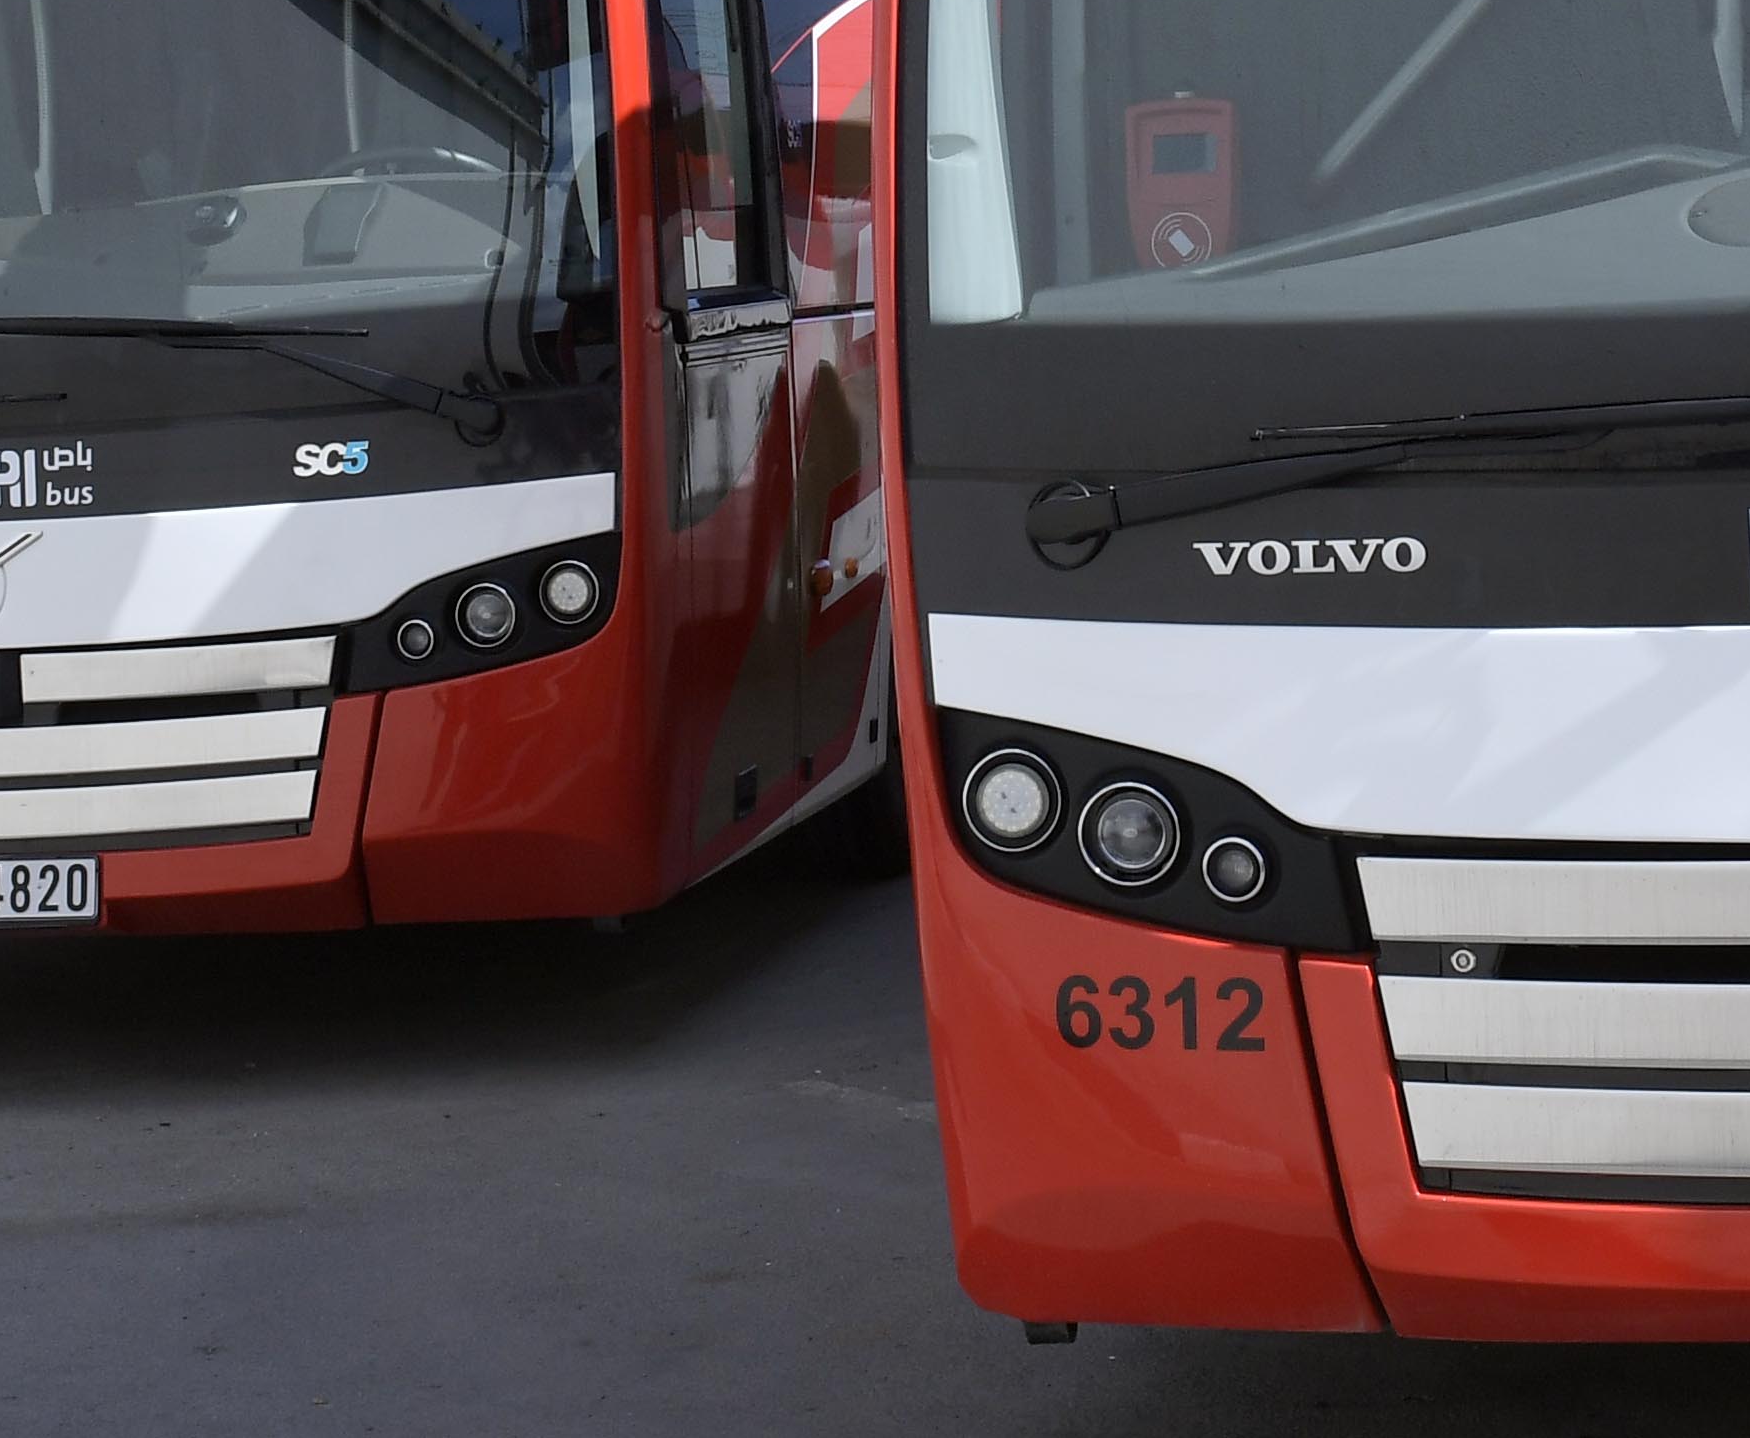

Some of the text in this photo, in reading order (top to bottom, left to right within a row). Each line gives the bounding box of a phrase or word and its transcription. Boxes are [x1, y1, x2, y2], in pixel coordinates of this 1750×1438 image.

[42, 440, 92, 472] باص
[293, 440, 369, 477] SC5
[45, 481, 94, 506] bus
[1192, 536, 1428, 575] VOLVO
[1056, 974, 1265, 1052] 6312
